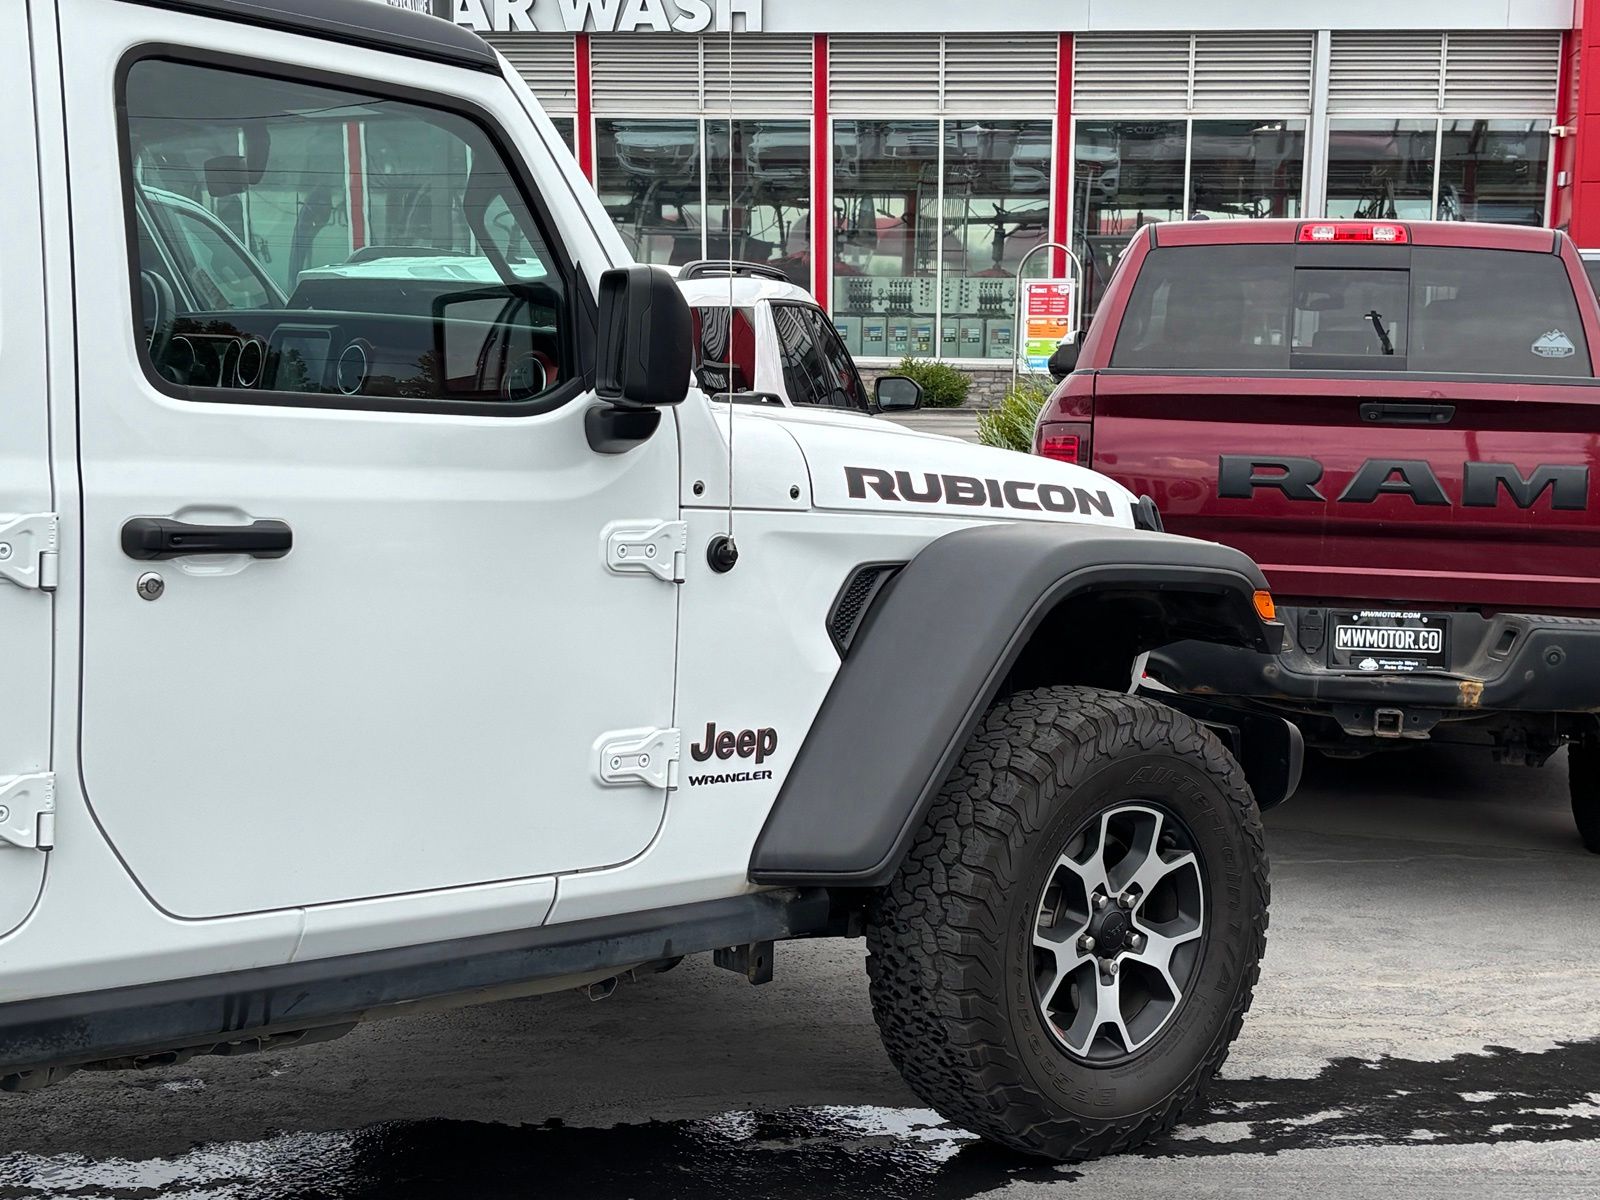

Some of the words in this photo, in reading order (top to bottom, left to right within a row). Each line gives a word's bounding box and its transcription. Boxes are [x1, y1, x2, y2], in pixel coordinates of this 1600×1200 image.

[454, 0, 538, 32] AR
[557, 0, 763, 32] WASH
[843, 466, 1115, 517] RUBICON
[1218, 454, 1590, 511] RAM
[1360, 610, 1421, 619] MWMOTOR.COM
[1339, 628, 1439, 650] MWMOTOR.CO
[690, 721, 778, 765] Jeep
[688, 770, 773, 787] WRANGLER
